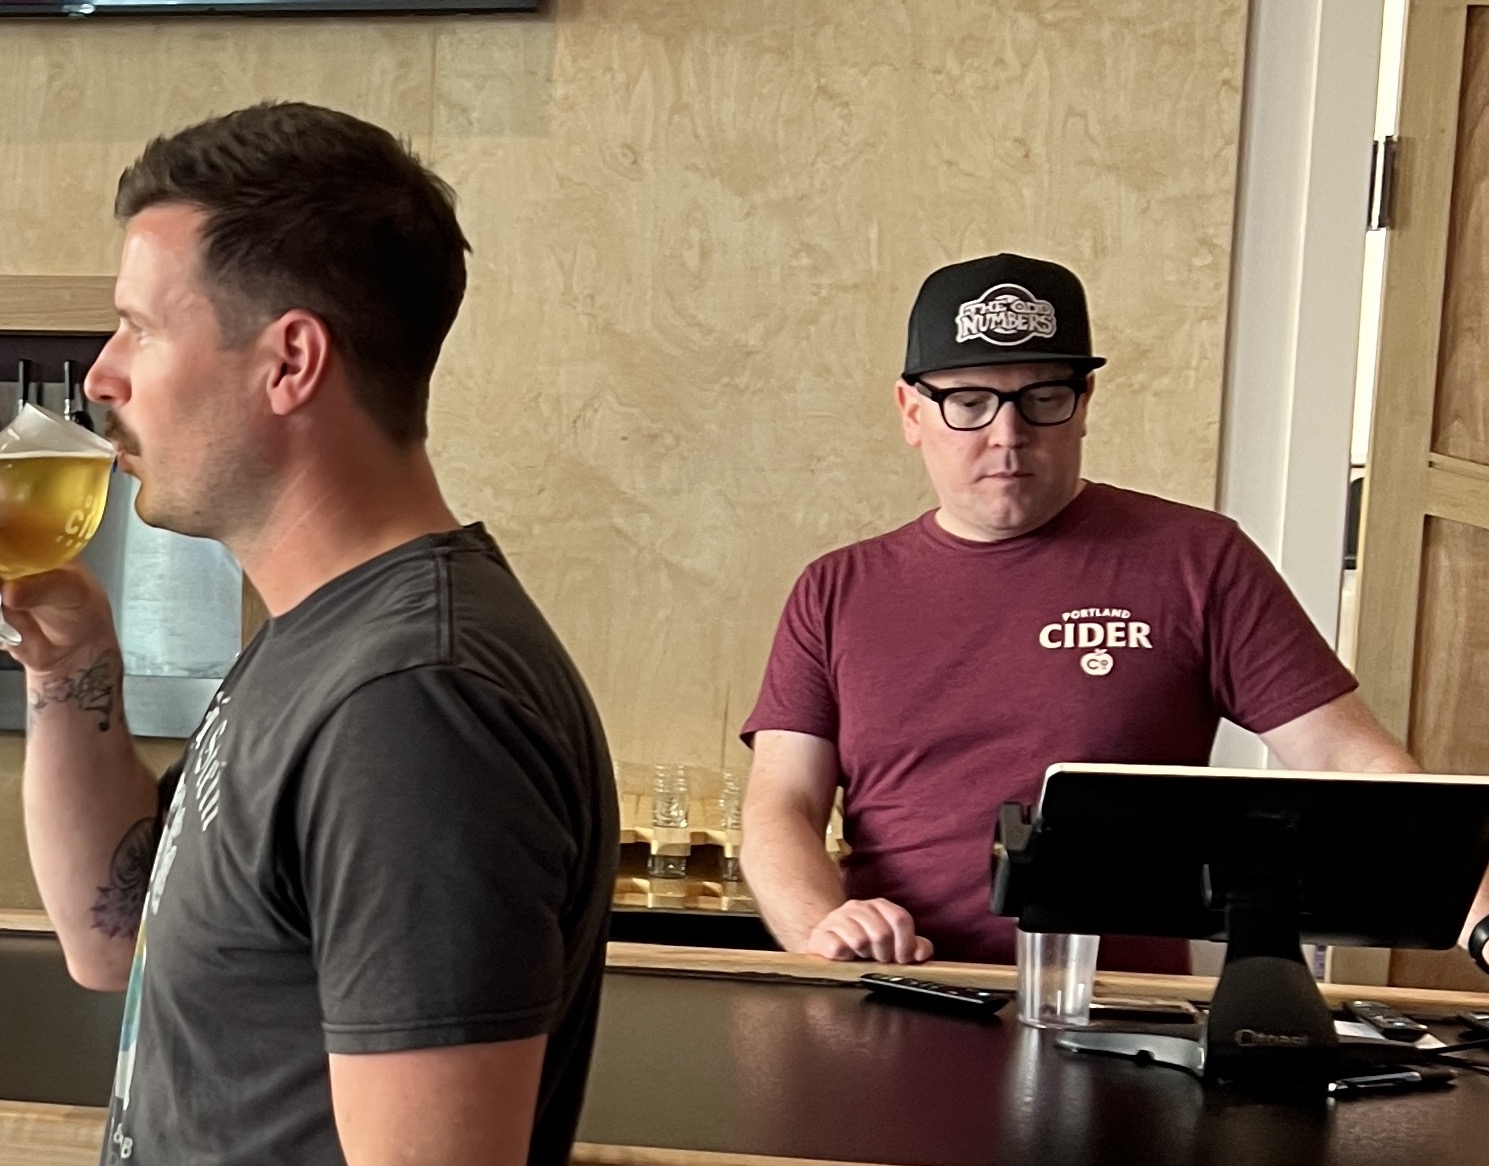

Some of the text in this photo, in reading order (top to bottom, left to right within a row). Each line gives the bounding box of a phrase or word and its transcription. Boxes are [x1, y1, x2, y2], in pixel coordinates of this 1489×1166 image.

[964, 300, 1052, 316] THE ODD
[961, 311, 1052, 337] NUMBERS
[1062, 607, 1131, 622] PORTLAND
[1038, 621, 1153, 649] CIDER
